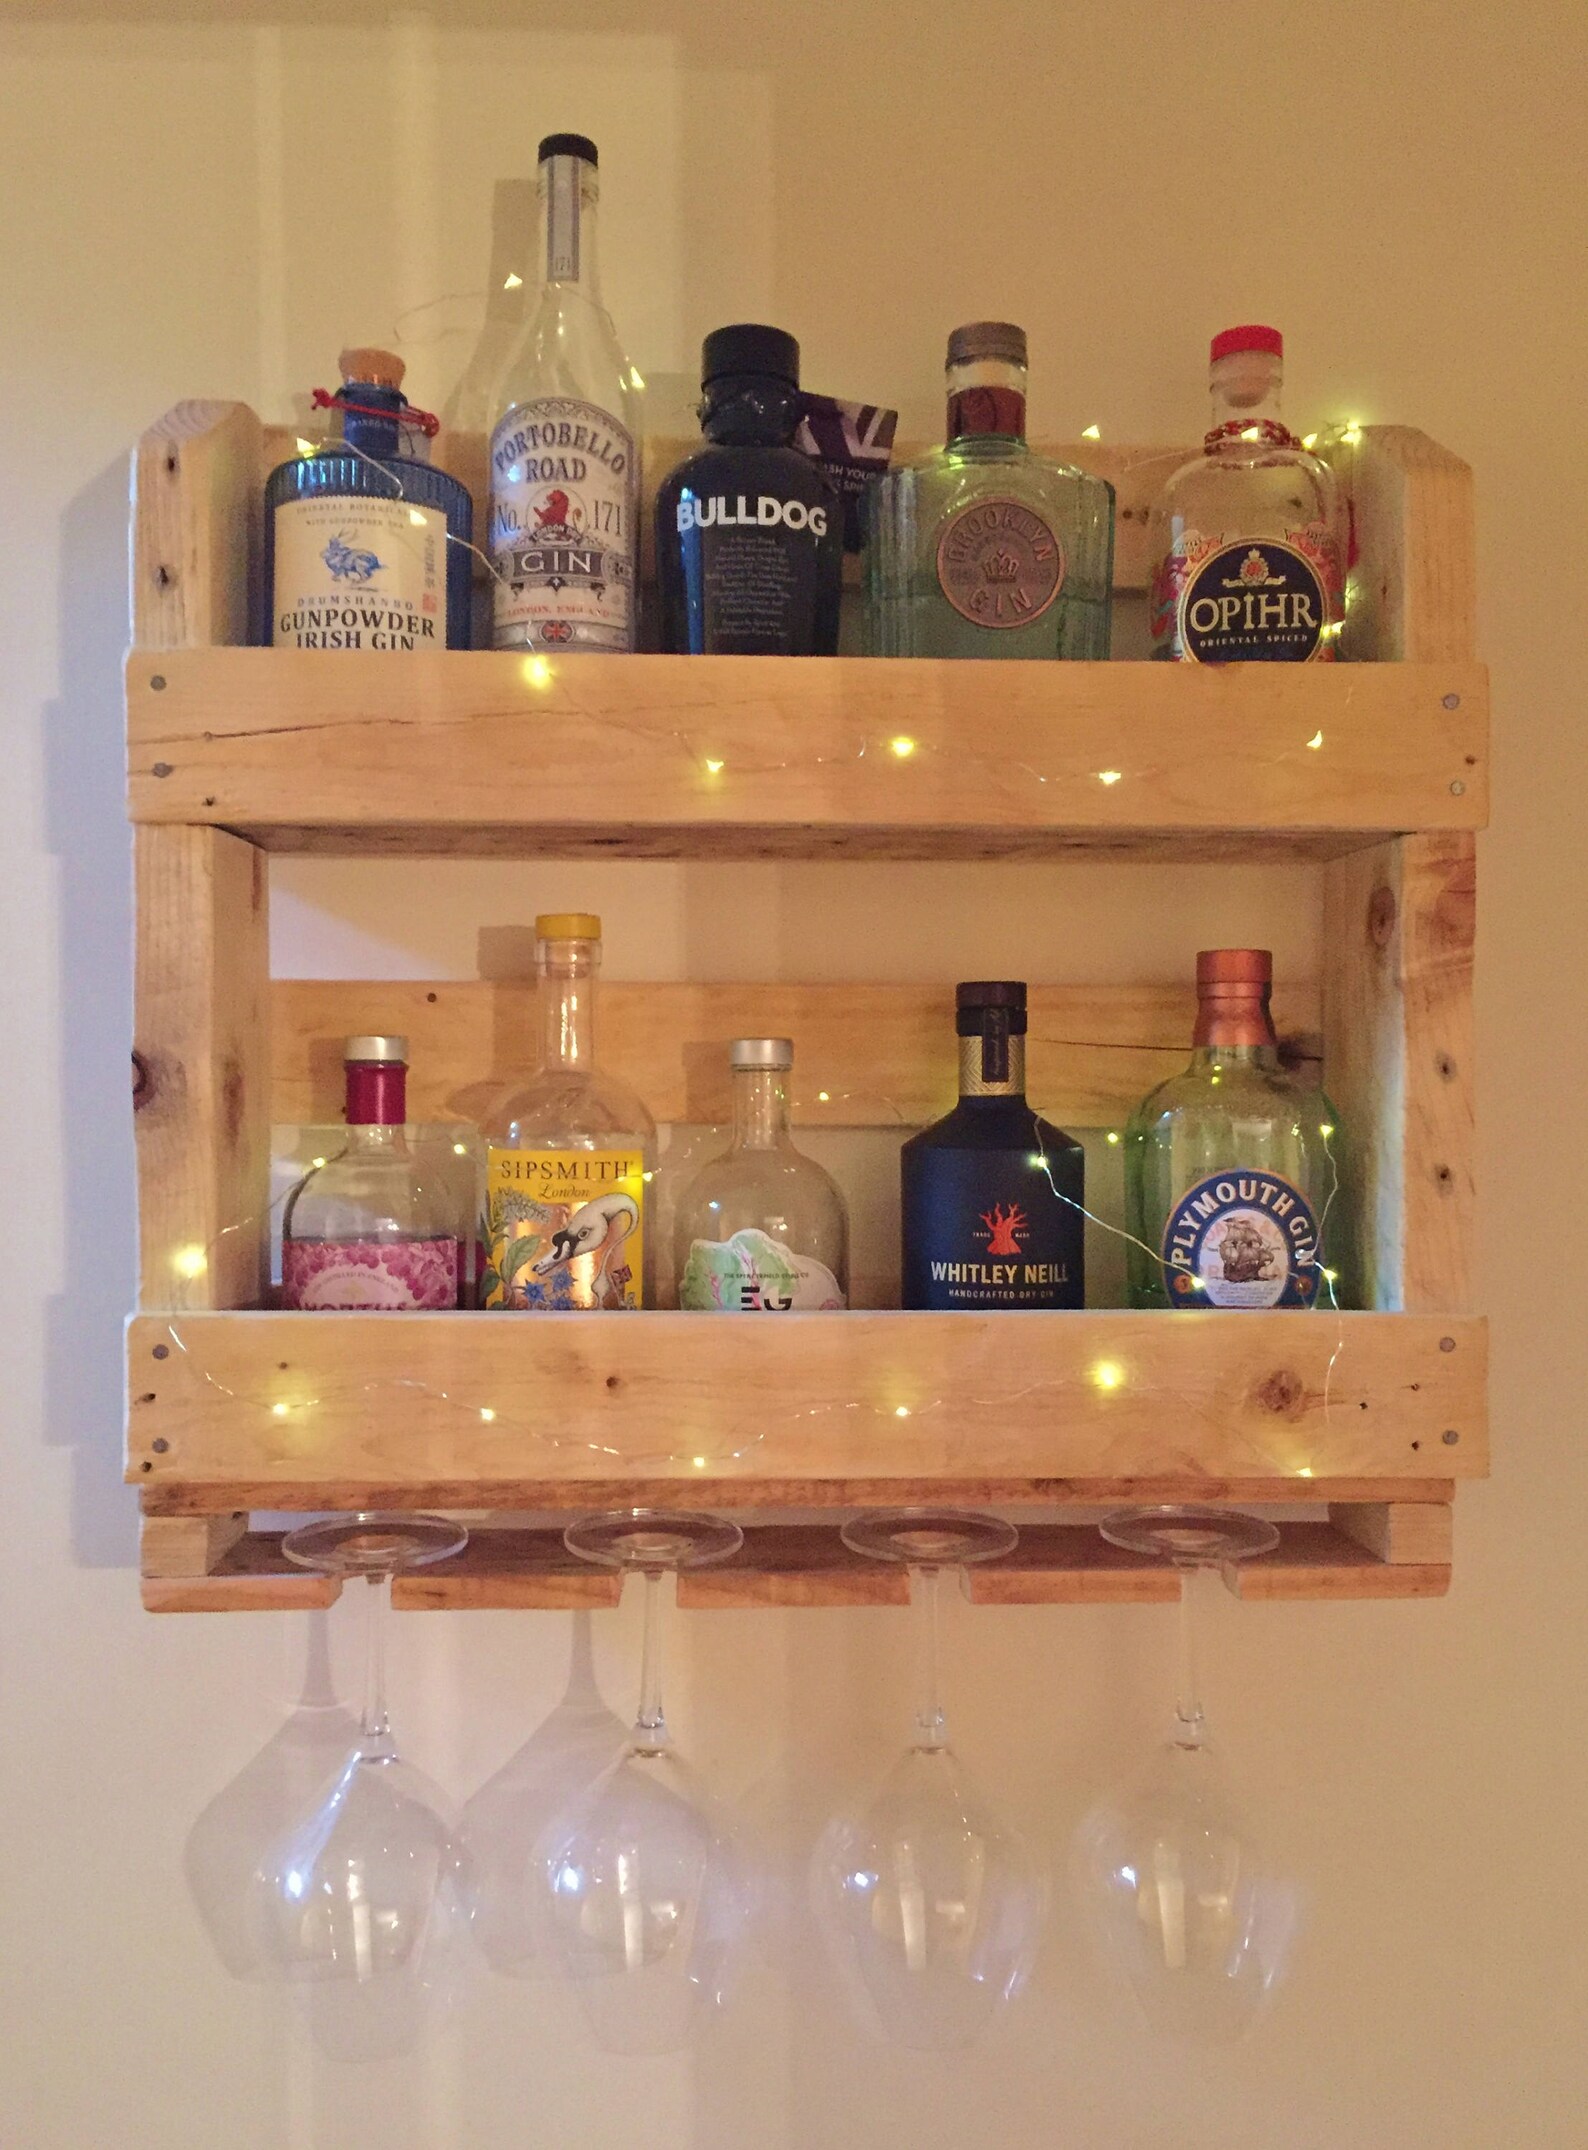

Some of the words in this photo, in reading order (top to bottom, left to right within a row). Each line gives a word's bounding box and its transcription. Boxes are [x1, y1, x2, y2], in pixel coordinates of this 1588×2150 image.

[495, 423, 625, 474] PORTOBELLO
[526, 457, 587, 482] ROAD
[498, 503, 521, 533] No.
[594, 500, 621, 537] 171
[677, 496, 827, 536] BULLDOG
[948, 507, 1053, 562] BROOKLYN
[521, 551, 591, 573] GIN
[969, 588, 1032, 616] GIN
[1190, 592, 1317, 633] OPIHR
[280, 608, 435, 639] GUNPOWDER
[296, 630, 361, 649] IRISH
[371, 632, 414, 650] GIN
[1200, 635, 1258, 648] ORIENTAL
[1266, 634, 1308, 643] SPICED
[501, 1160, 629, 1180] SIPSMITH
[538, 1182, 591, 1199] London
[1171, 1179, 1296, 1266] PLYMOUTH
[1289, 1215, 1316, 1267] GIN
[931, 1261, 1018, 1284] WHITLEY
[1025, 1263, 1068, 1284] NEILL
[949, 1289, 1015, 1299] HANDCRAFTED
[1019, 1290, 1037, 1299] DRY
